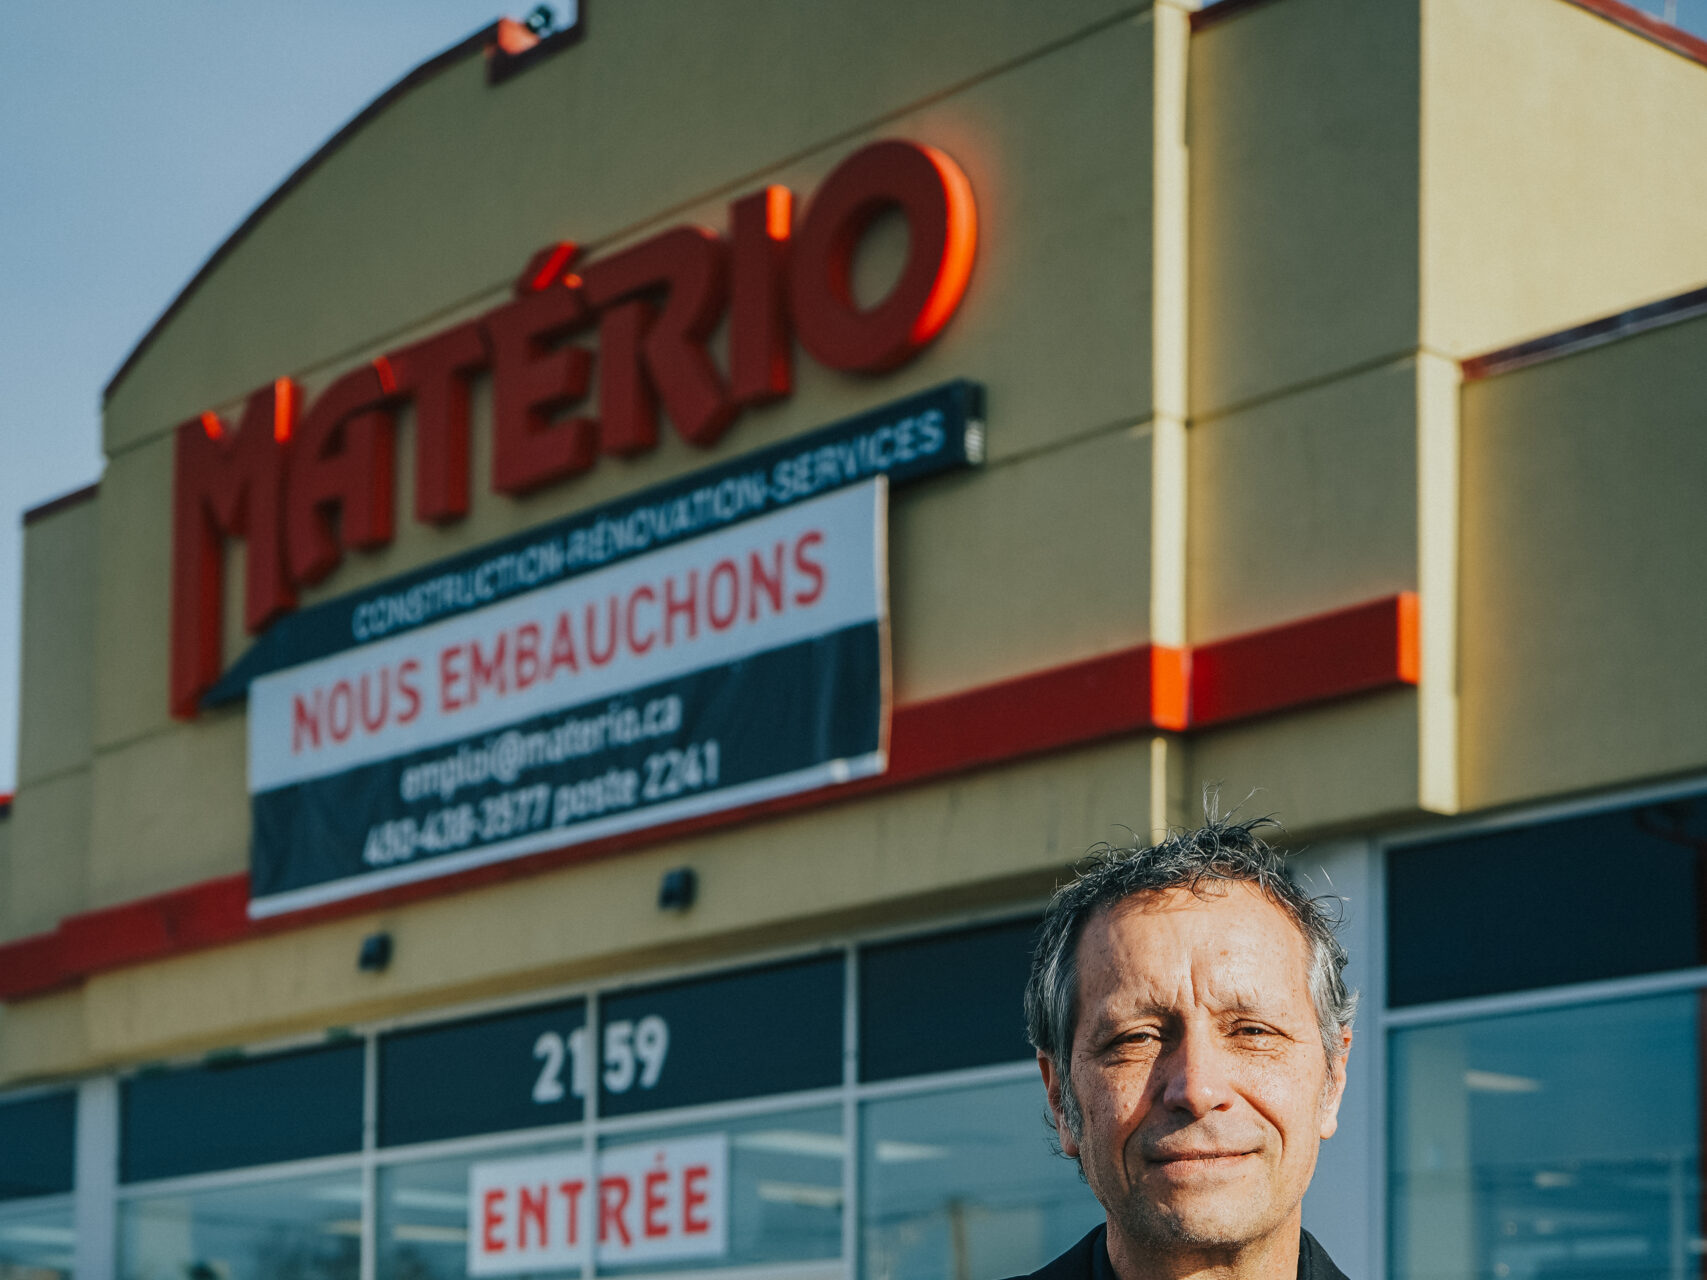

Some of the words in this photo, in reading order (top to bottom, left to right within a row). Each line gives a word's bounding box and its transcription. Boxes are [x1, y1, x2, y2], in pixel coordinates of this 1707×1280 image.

[170, 138, 979, 720] MATÉRIO
[291, 660, 422, 755] NOUS
[439, 530, 826, 716] EMBAUCHONS
[533, 1015, 670, 1102] 2159
[482, 1150, 712, 1255] ENTRÉE
